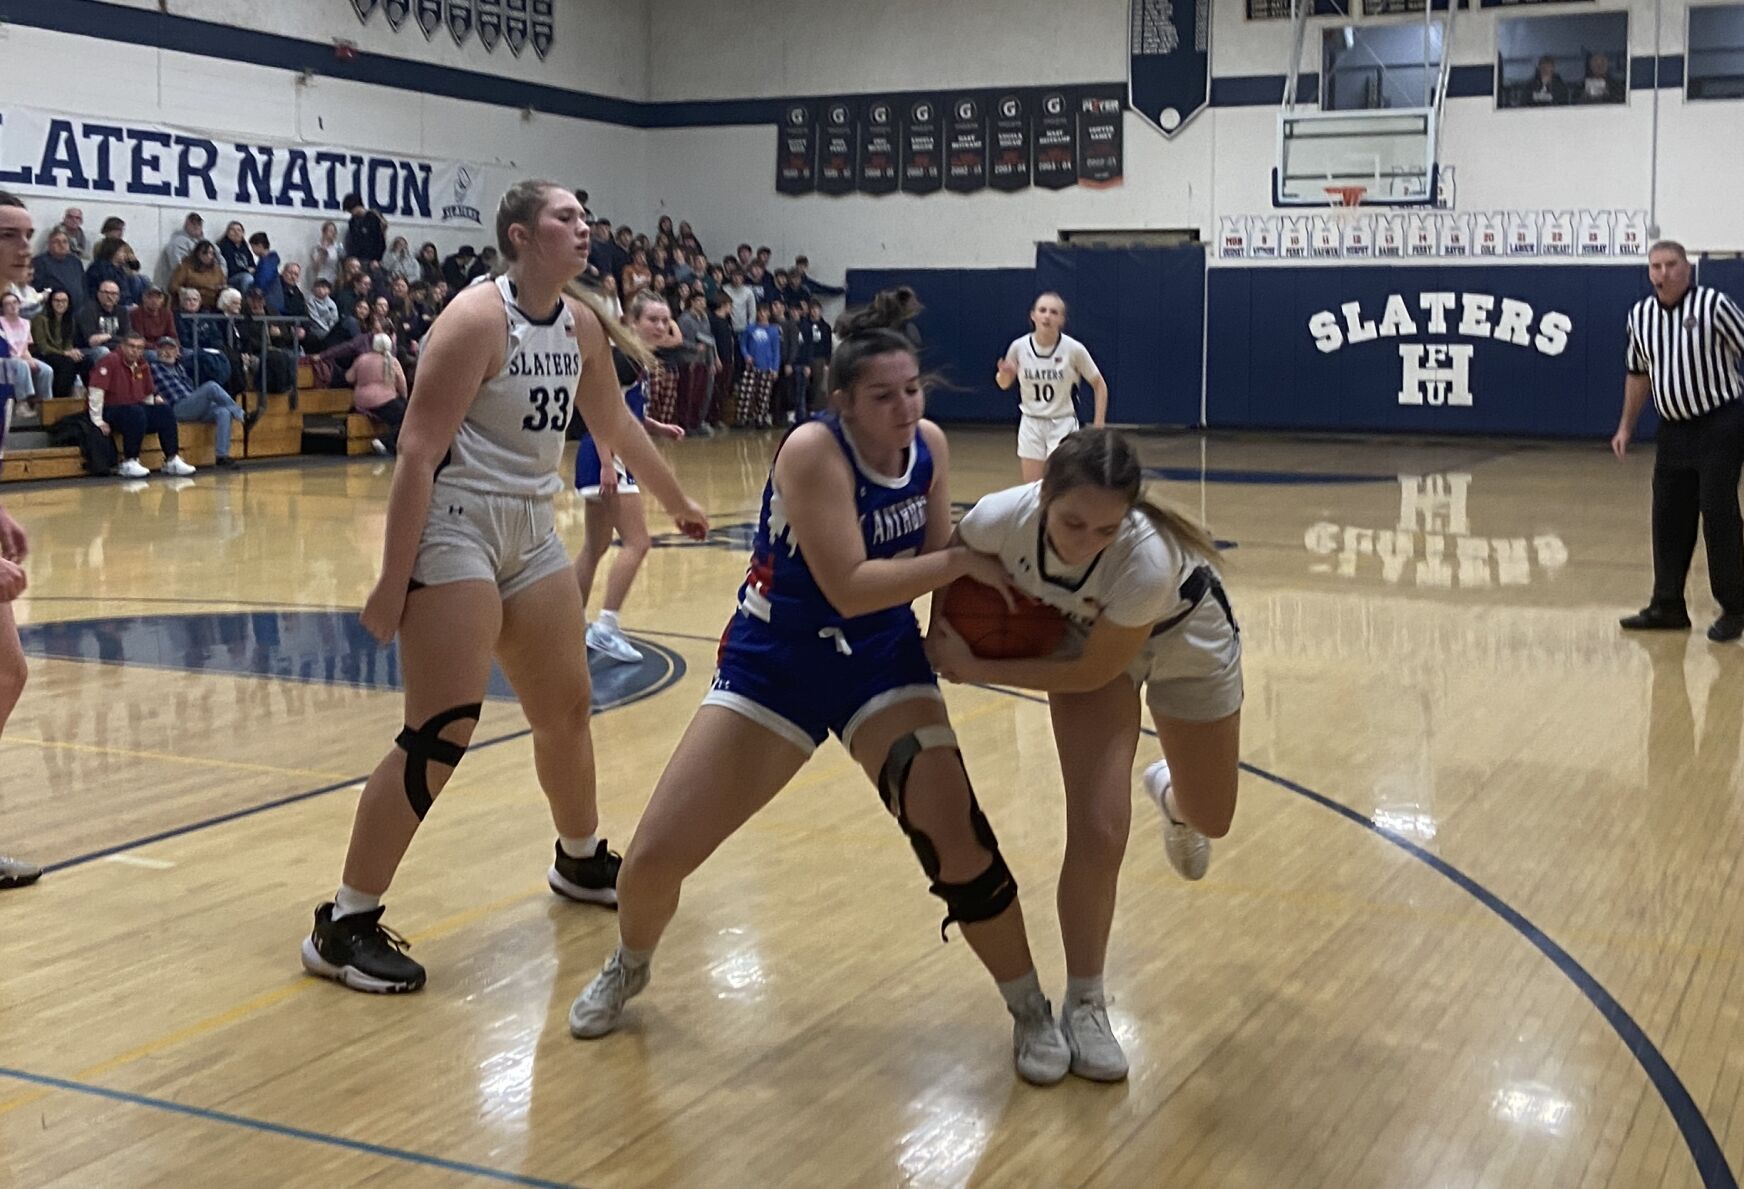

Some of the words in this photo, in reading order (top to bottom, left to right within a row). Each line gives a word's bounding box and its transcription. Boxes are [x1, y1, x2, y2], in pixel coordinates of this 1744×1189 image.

[234, 143, 433, 219] NATION
[1308, 292, 1572, 356] SLATERS
[509, 352, 579, 377] SLATERS
[1024, 368, 1065, 382] SLATERS
[522, 386, 570, 432] 33
[1033, 383, 1055, 403] 10
